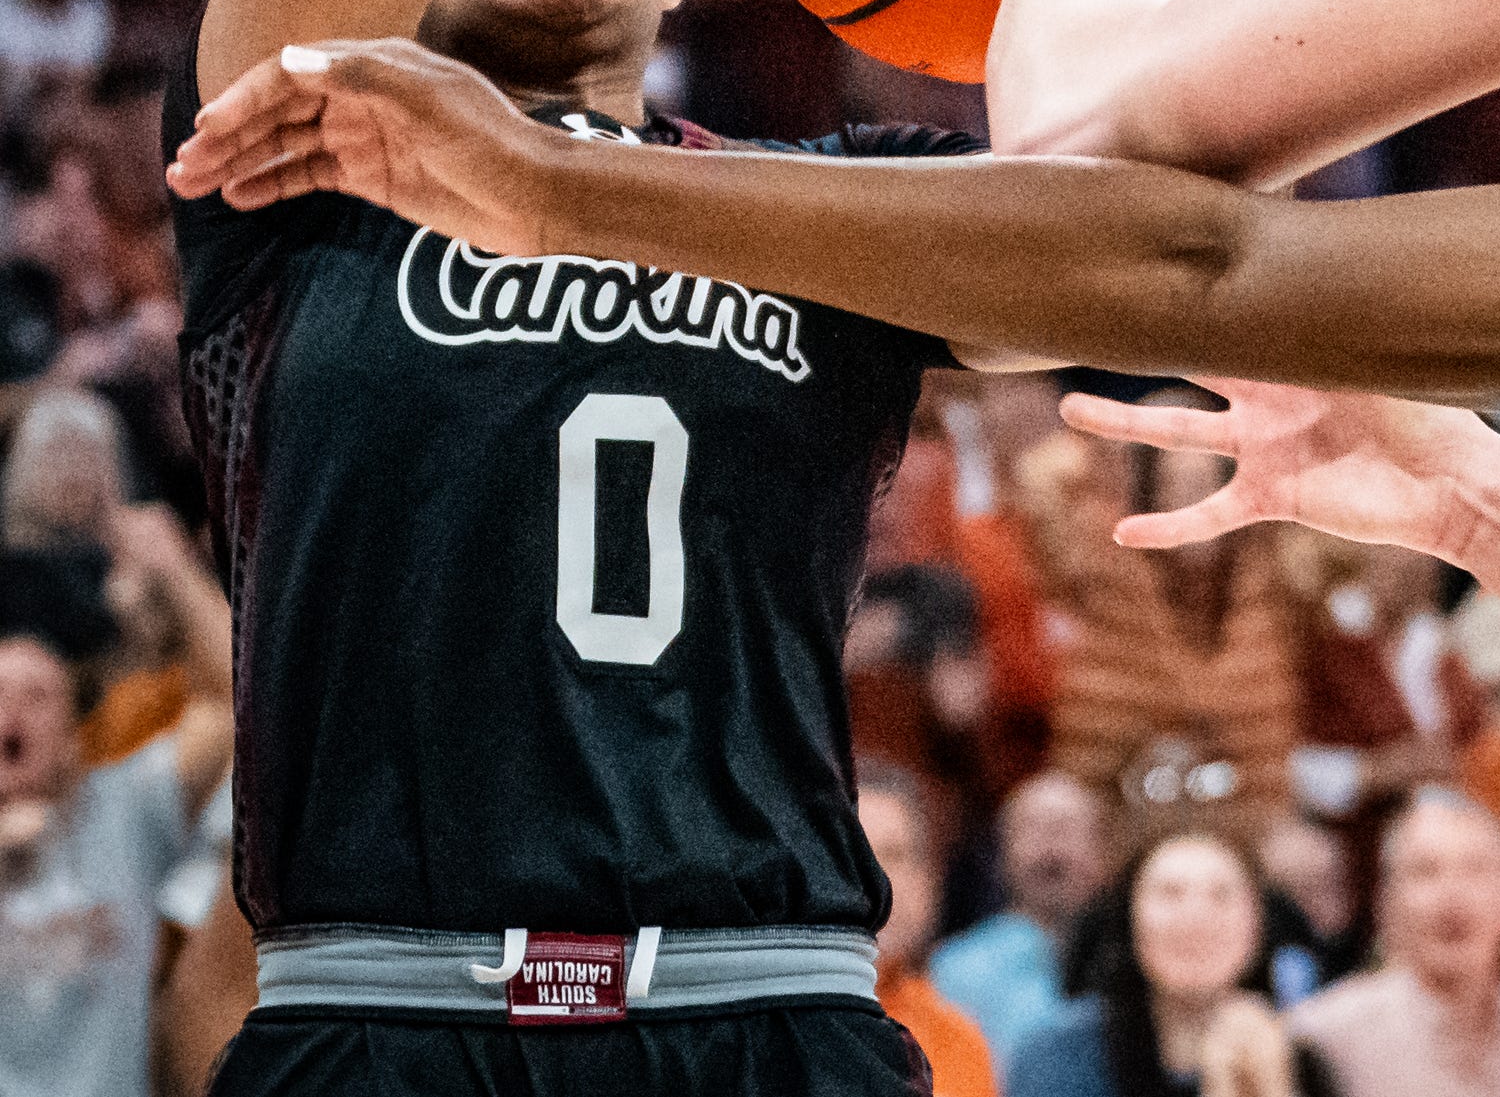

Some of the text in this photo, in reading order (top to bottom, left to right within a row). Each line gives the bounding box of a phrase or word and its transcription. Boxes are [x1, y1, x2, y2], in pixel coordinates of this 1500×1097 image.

[556, 394, 690, 666] 0
[522, 960, 612, 985] CAROLINA
[537, 984, 597, 1005] SOUTH
